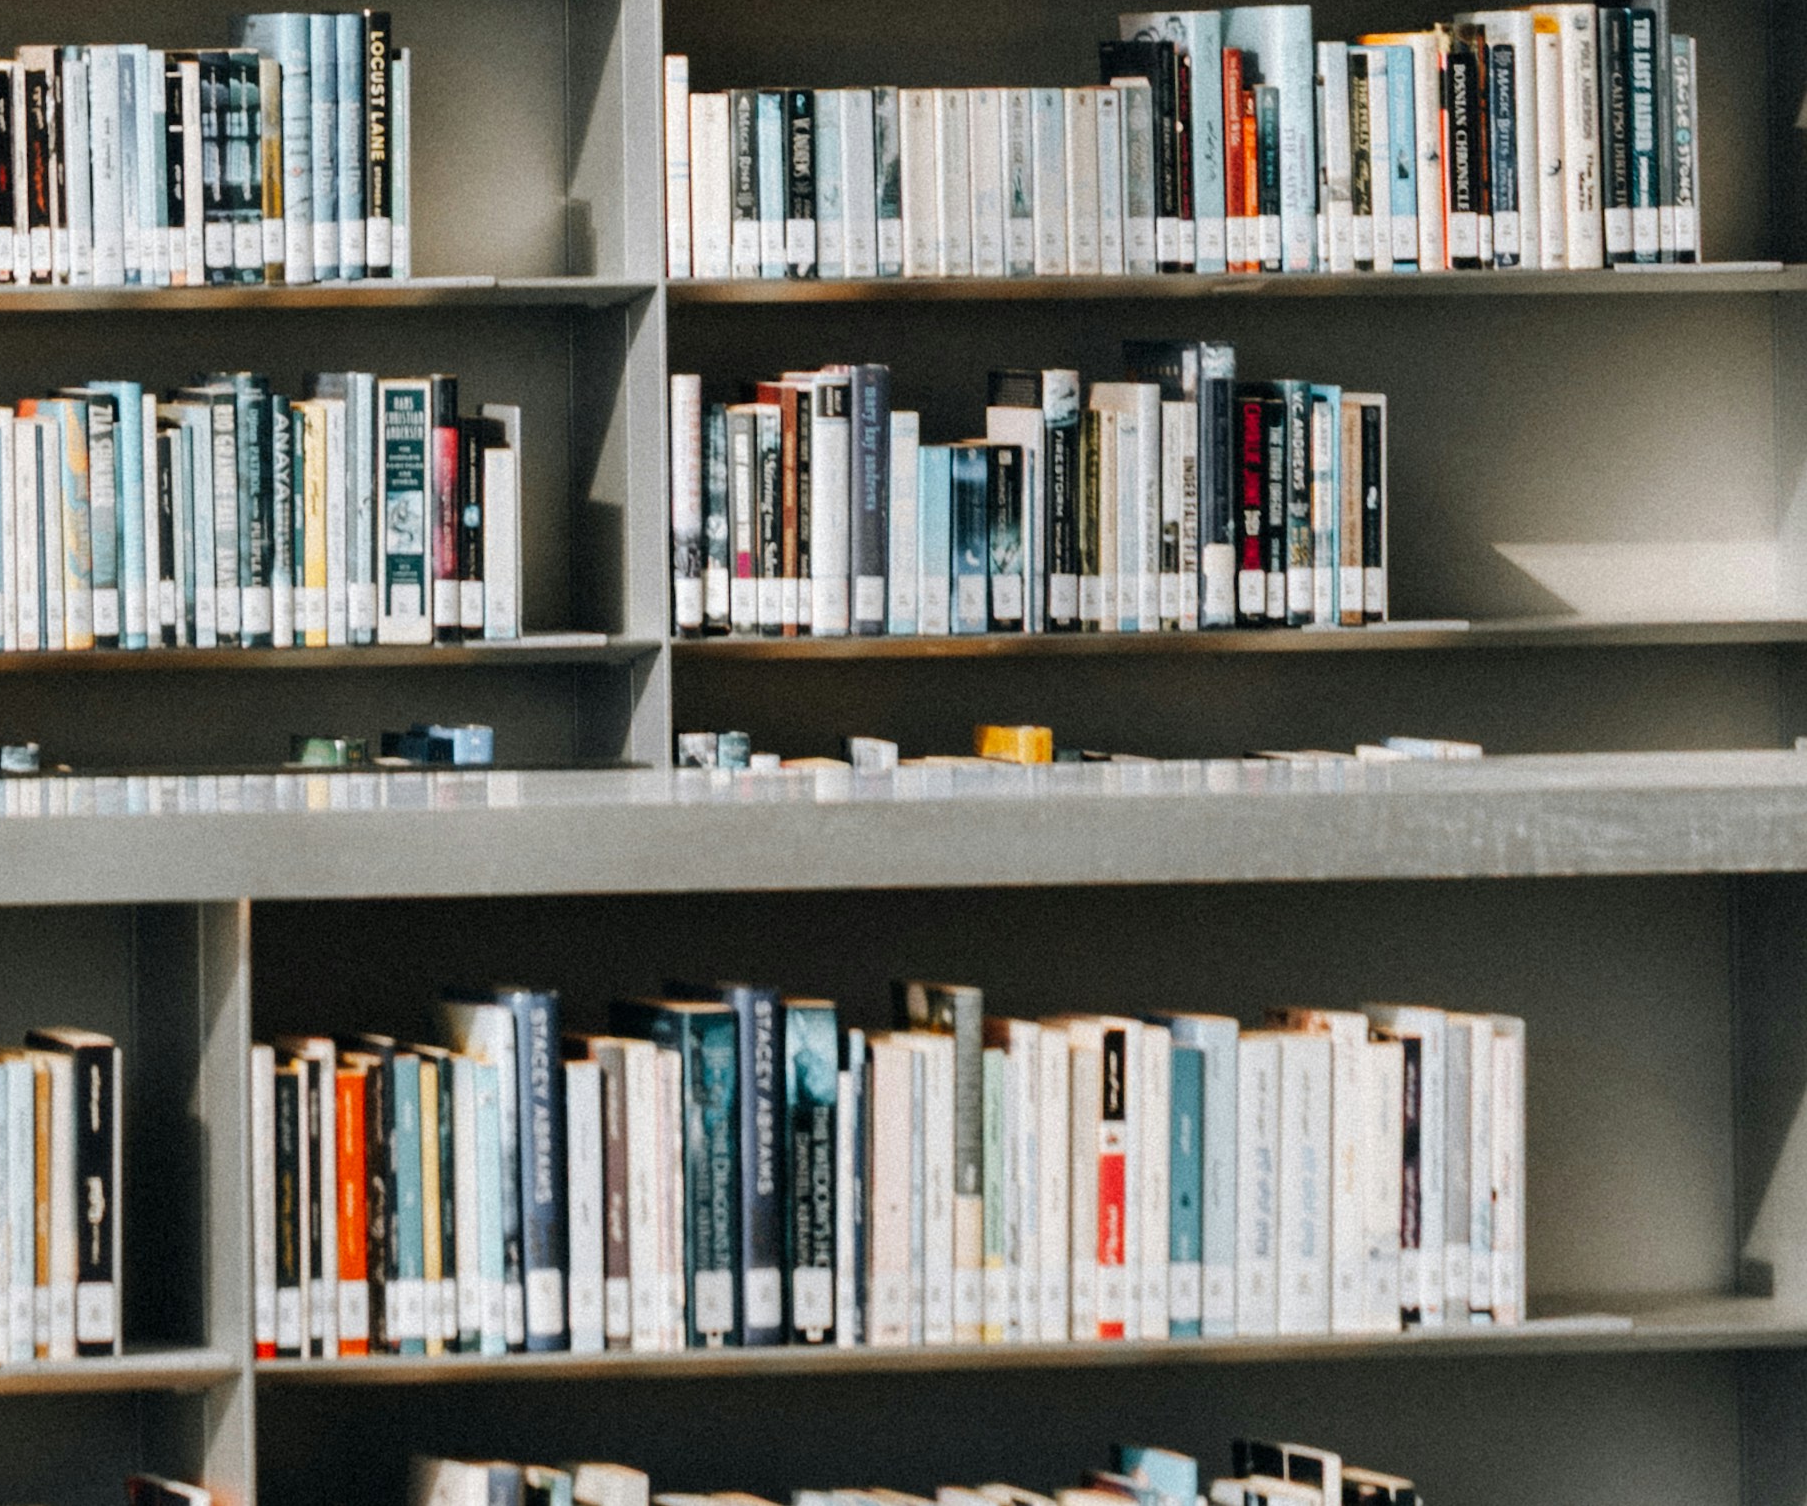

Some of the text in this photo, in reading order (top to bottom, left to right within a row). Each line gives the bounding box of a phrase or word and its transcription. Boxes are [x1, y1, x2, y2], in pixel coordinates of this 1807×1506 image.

[1634, 18, 1650, 49] THE
[1634, 53, 1651, 89] LAST
[370, 31, 385, 161] LOCUST LANE
[274, 412, 290, 502] ANAYA
[1055, 430, 1063, 517] FIRESTORM
[1293, 420, 1305, 490] ANDREWS
[755, 1000, 774, 1195] STACEY ABRAMS
